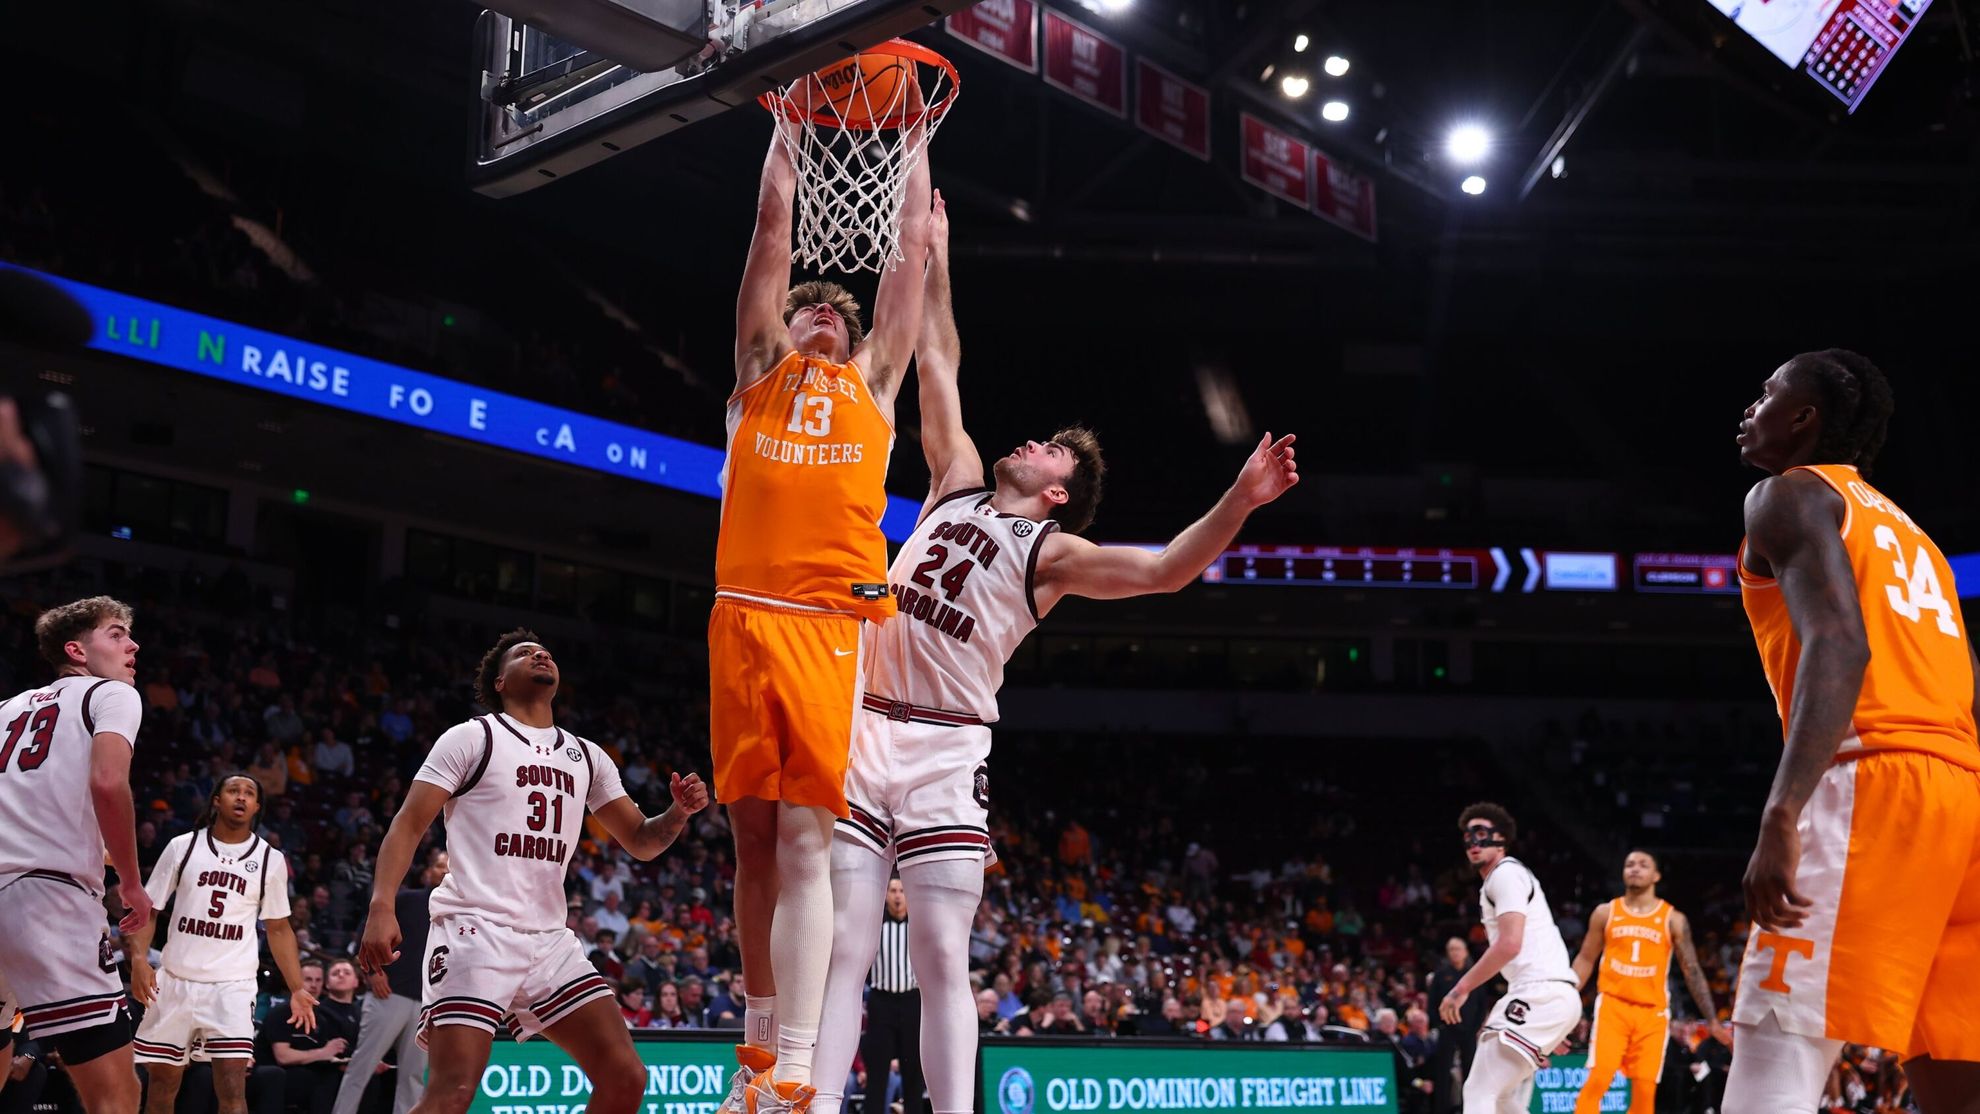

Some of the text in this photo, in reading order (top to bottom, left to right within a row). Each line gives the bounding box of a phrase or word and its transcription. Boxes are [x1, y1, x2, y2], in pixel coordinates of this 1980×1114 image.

[242, 345, 350, 396] RAISE
[469, 399, 488, 431] E
[787, 392, 833, 437] 13
[754, 432, 864, 465] VOLUNTEERS
[928, 521, 1000, 571] SOUTH
[911, 543, 975, 603] 24
[1873, 524, 1960, 639] 34
[0, 702, 61, 773] 13
[516, 764, 575, 798] SOUTH
[526, 790, 563, 835] 31
[197, 870, 248, 896] SOUTH
[208, 890, 228, 919] 5
[177, 916, 243, 941] CAROLINA
[1630, 940, 1641, 963] 1
[481, 1065, 550, 1098] OLD
[1046, 1076, 1387, 1111] OLD DOMINION FREIGHT LINE
